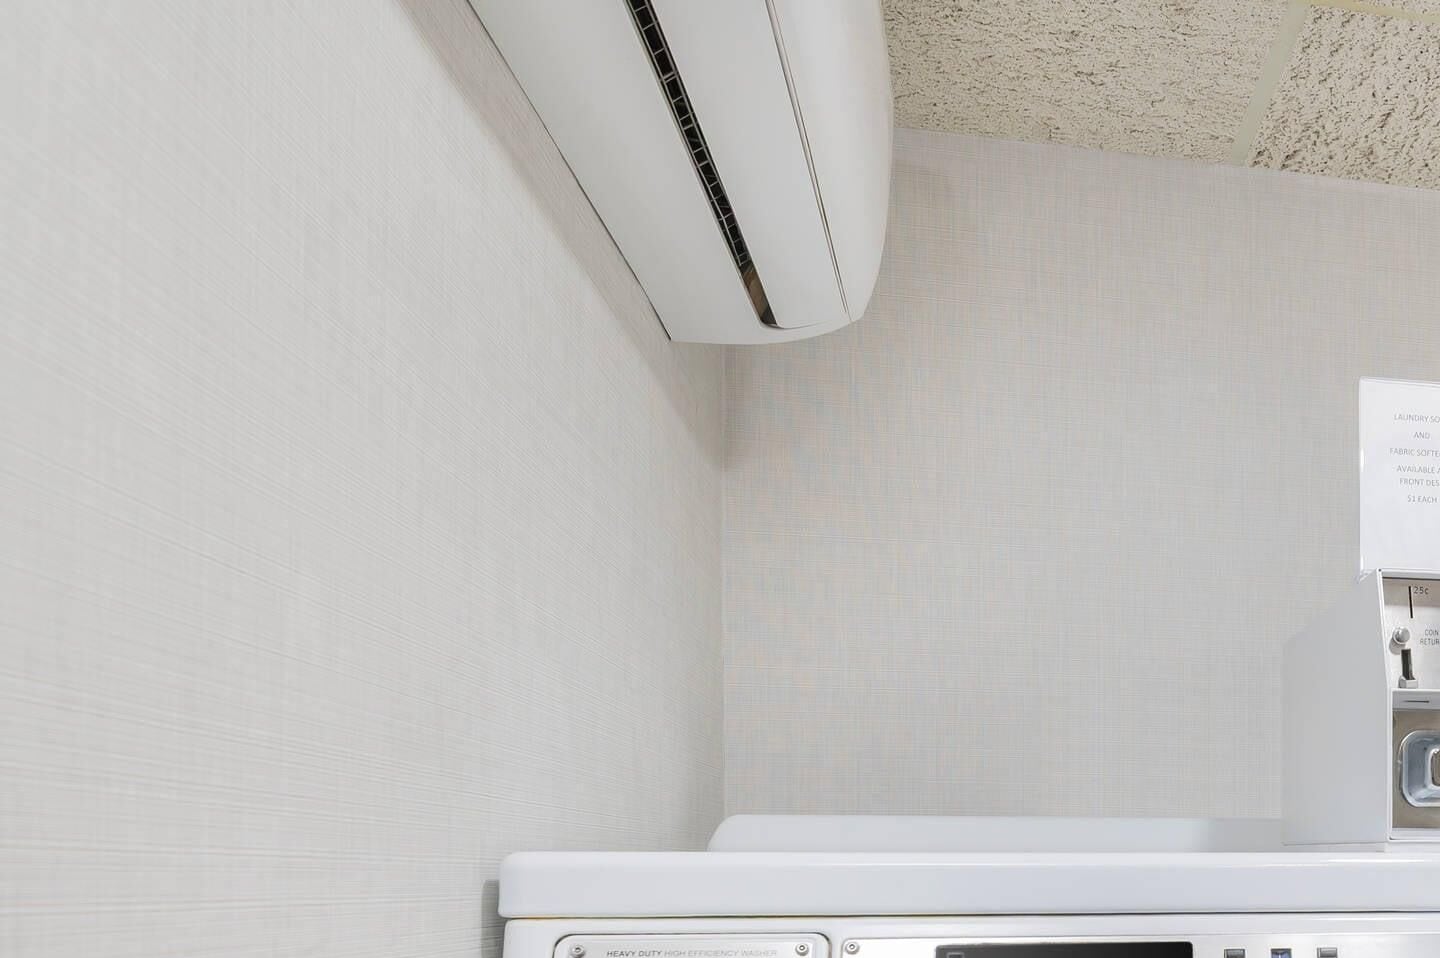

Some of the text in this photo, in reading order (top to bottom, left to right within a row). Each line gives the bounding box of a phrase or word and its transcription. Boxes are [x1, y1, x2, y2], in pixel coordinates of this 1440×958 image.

[1393, 413, 1429, 422] LAUNDRY
[1413, 431, 1431, 440] AND
[1389, 447, 1415, 457] FABRIC
[1396, 465, 1436, 474] AVAILABLE
[1400, 477, 1425, 486] FRONT
[1417, 495, 1438, 504] EACH
[606, 950, 637, 958] HEAVY
[687, 949, 738, 957] EFFICIENCY
[741, 949, 777, 957] WASHER
